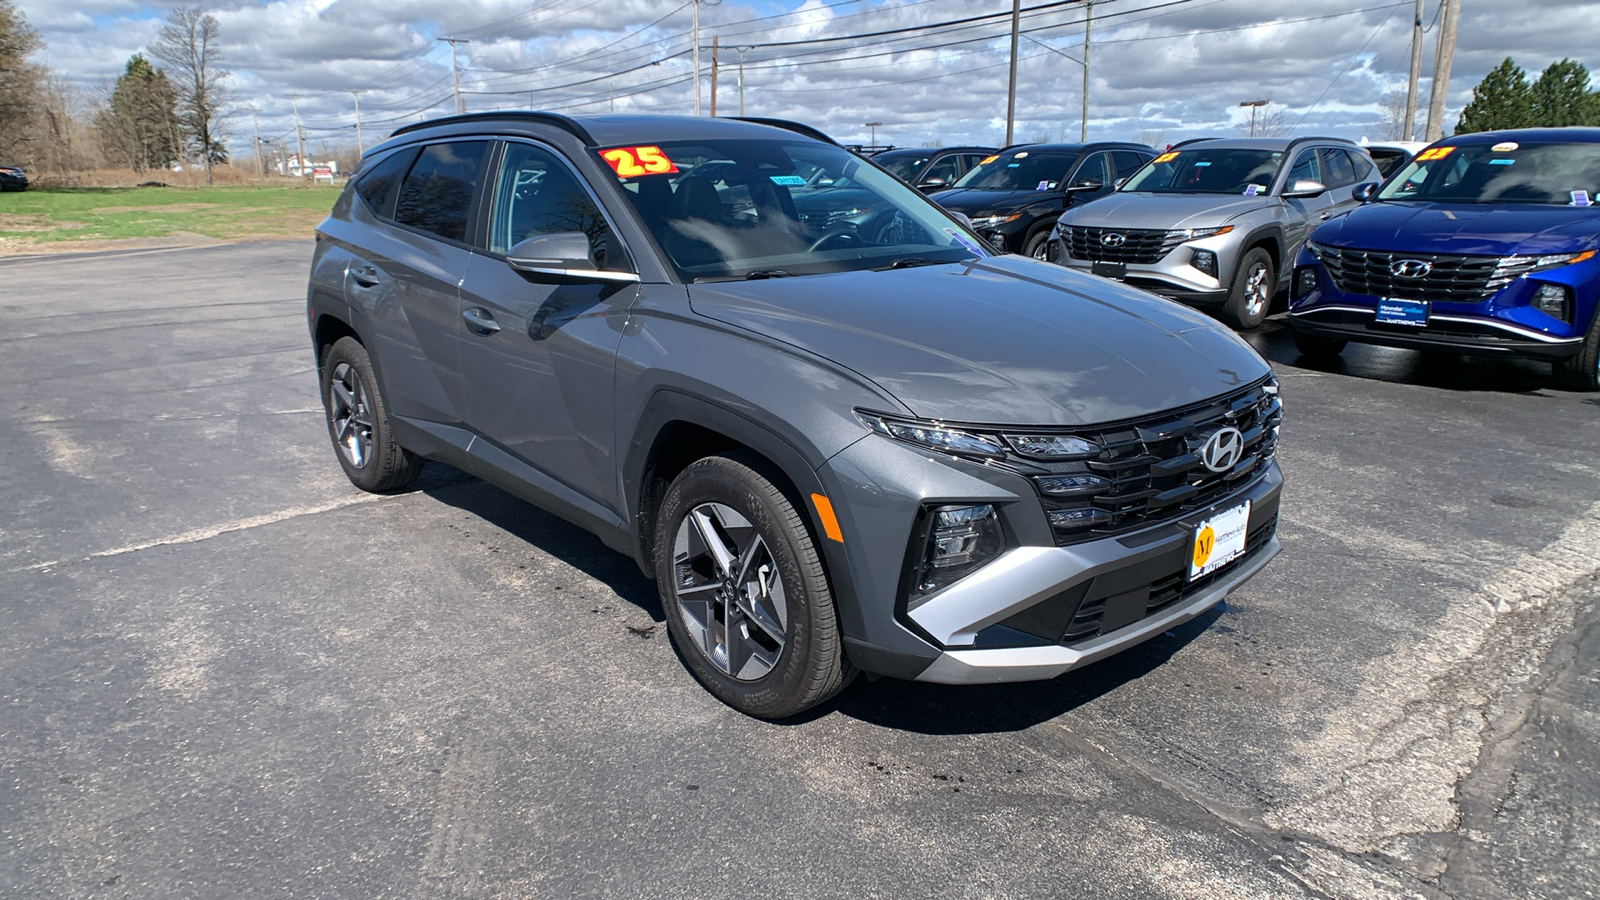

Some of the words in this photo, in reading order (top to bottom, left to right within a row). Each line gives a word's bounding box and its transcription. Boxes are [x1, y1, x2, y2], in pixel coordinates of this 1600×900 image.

[604, 147, 671, 176] 25
[1416, 147, 1455, 161] 23
[1197, 535, 1211, 560] M
[1204, 554, 1235, 575] MATTHEWS
